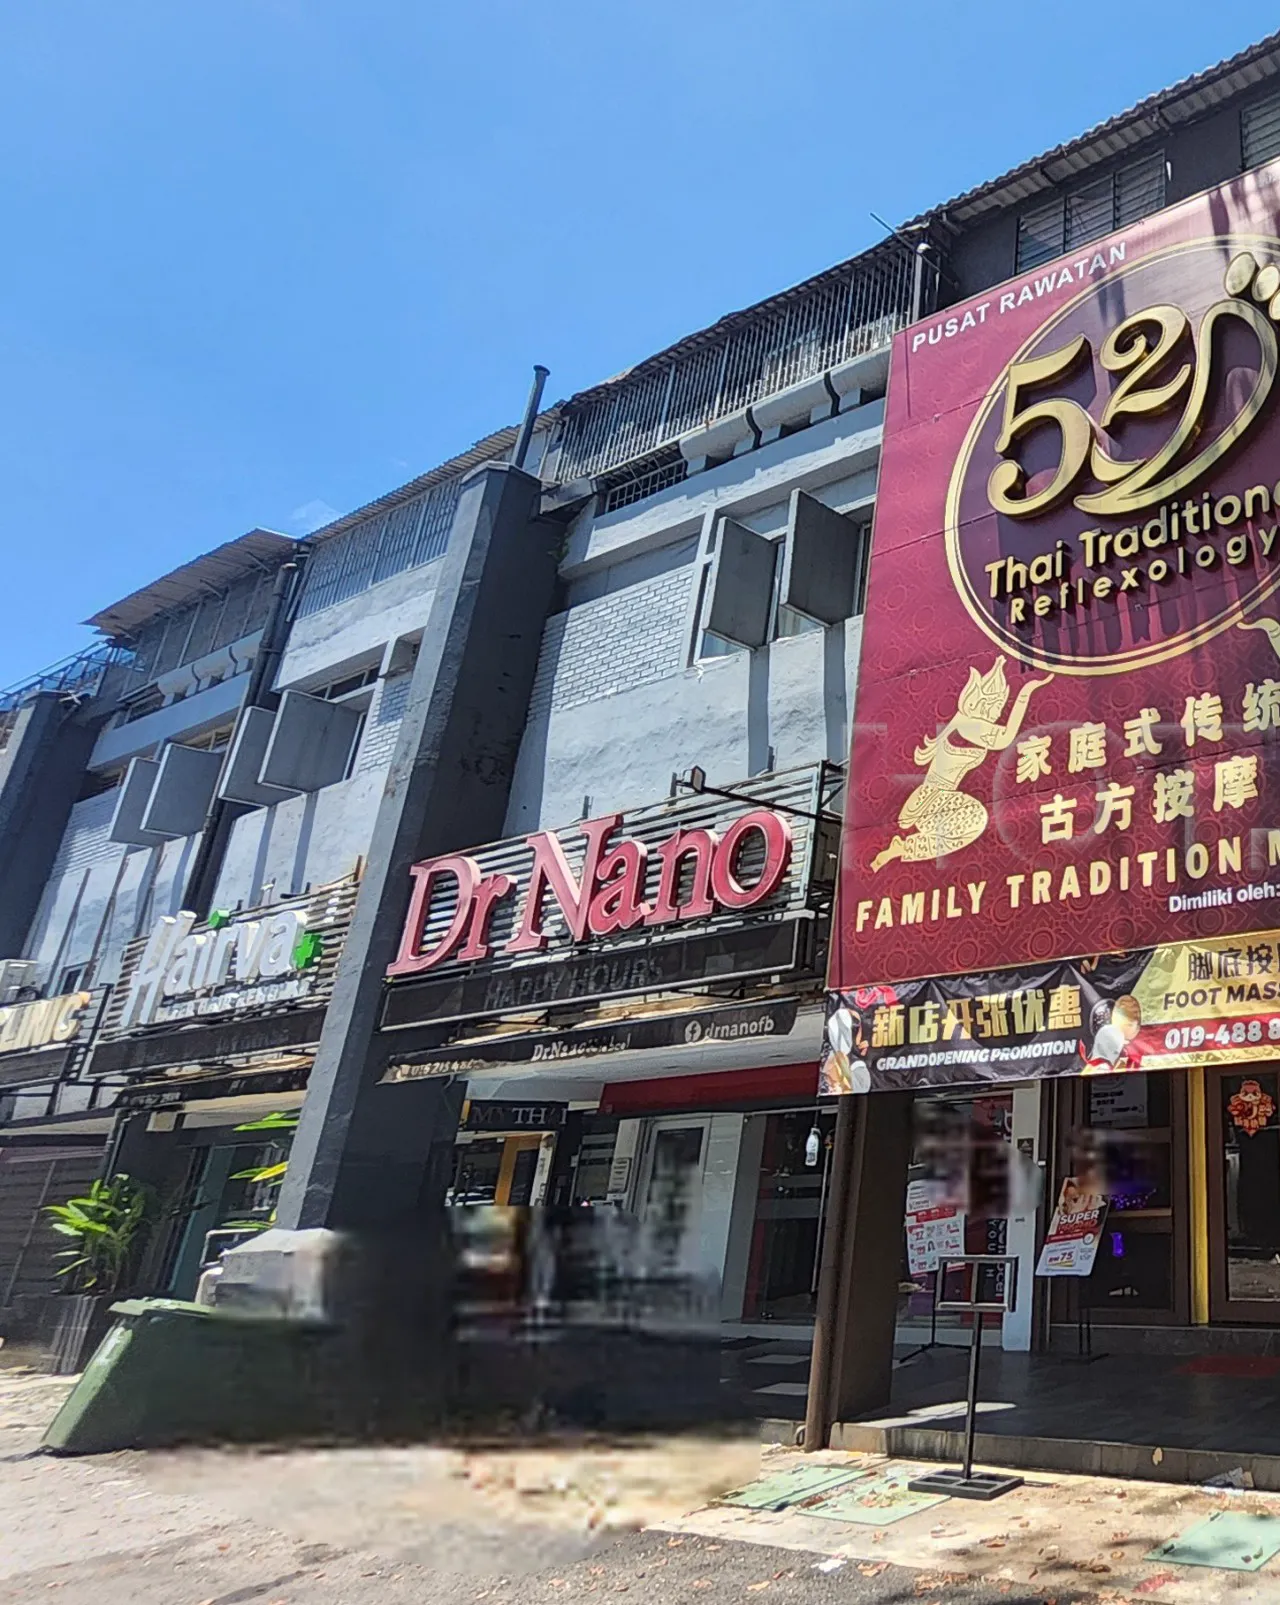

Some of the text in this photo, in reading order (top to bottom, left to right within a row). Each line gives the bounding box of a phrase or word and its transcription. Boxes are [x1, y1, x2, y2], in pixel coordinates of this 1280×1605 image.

[911, 242, 1128, 353] PUSAT RAWATAN
[984, 540, 1066, 599] Thai
[1009, 523, 1279, 624] Reflexology
[1039, 754, 1260, 845] 古方按摩
[386, 810, 793, 977] Dr Nano
[855, 880, 987, 933] FAMILY
[1005, 836, 1243, 909] TRADITION
[1168, 885, 1233, 914] Dimiliki
[0, 992, 90, 1053] LINIC
[703, 1016, 775, 1038] drnanofb
[871, 983, 1082, 1049] 新店开张优惠
[1162, 989, 1221, 1011] FOOT
[1165, 1017, 1264, 1051] 019-488
[511, 1106, 569, 1125] THI
[1059, 1209, 1100, 1225] SUPER
